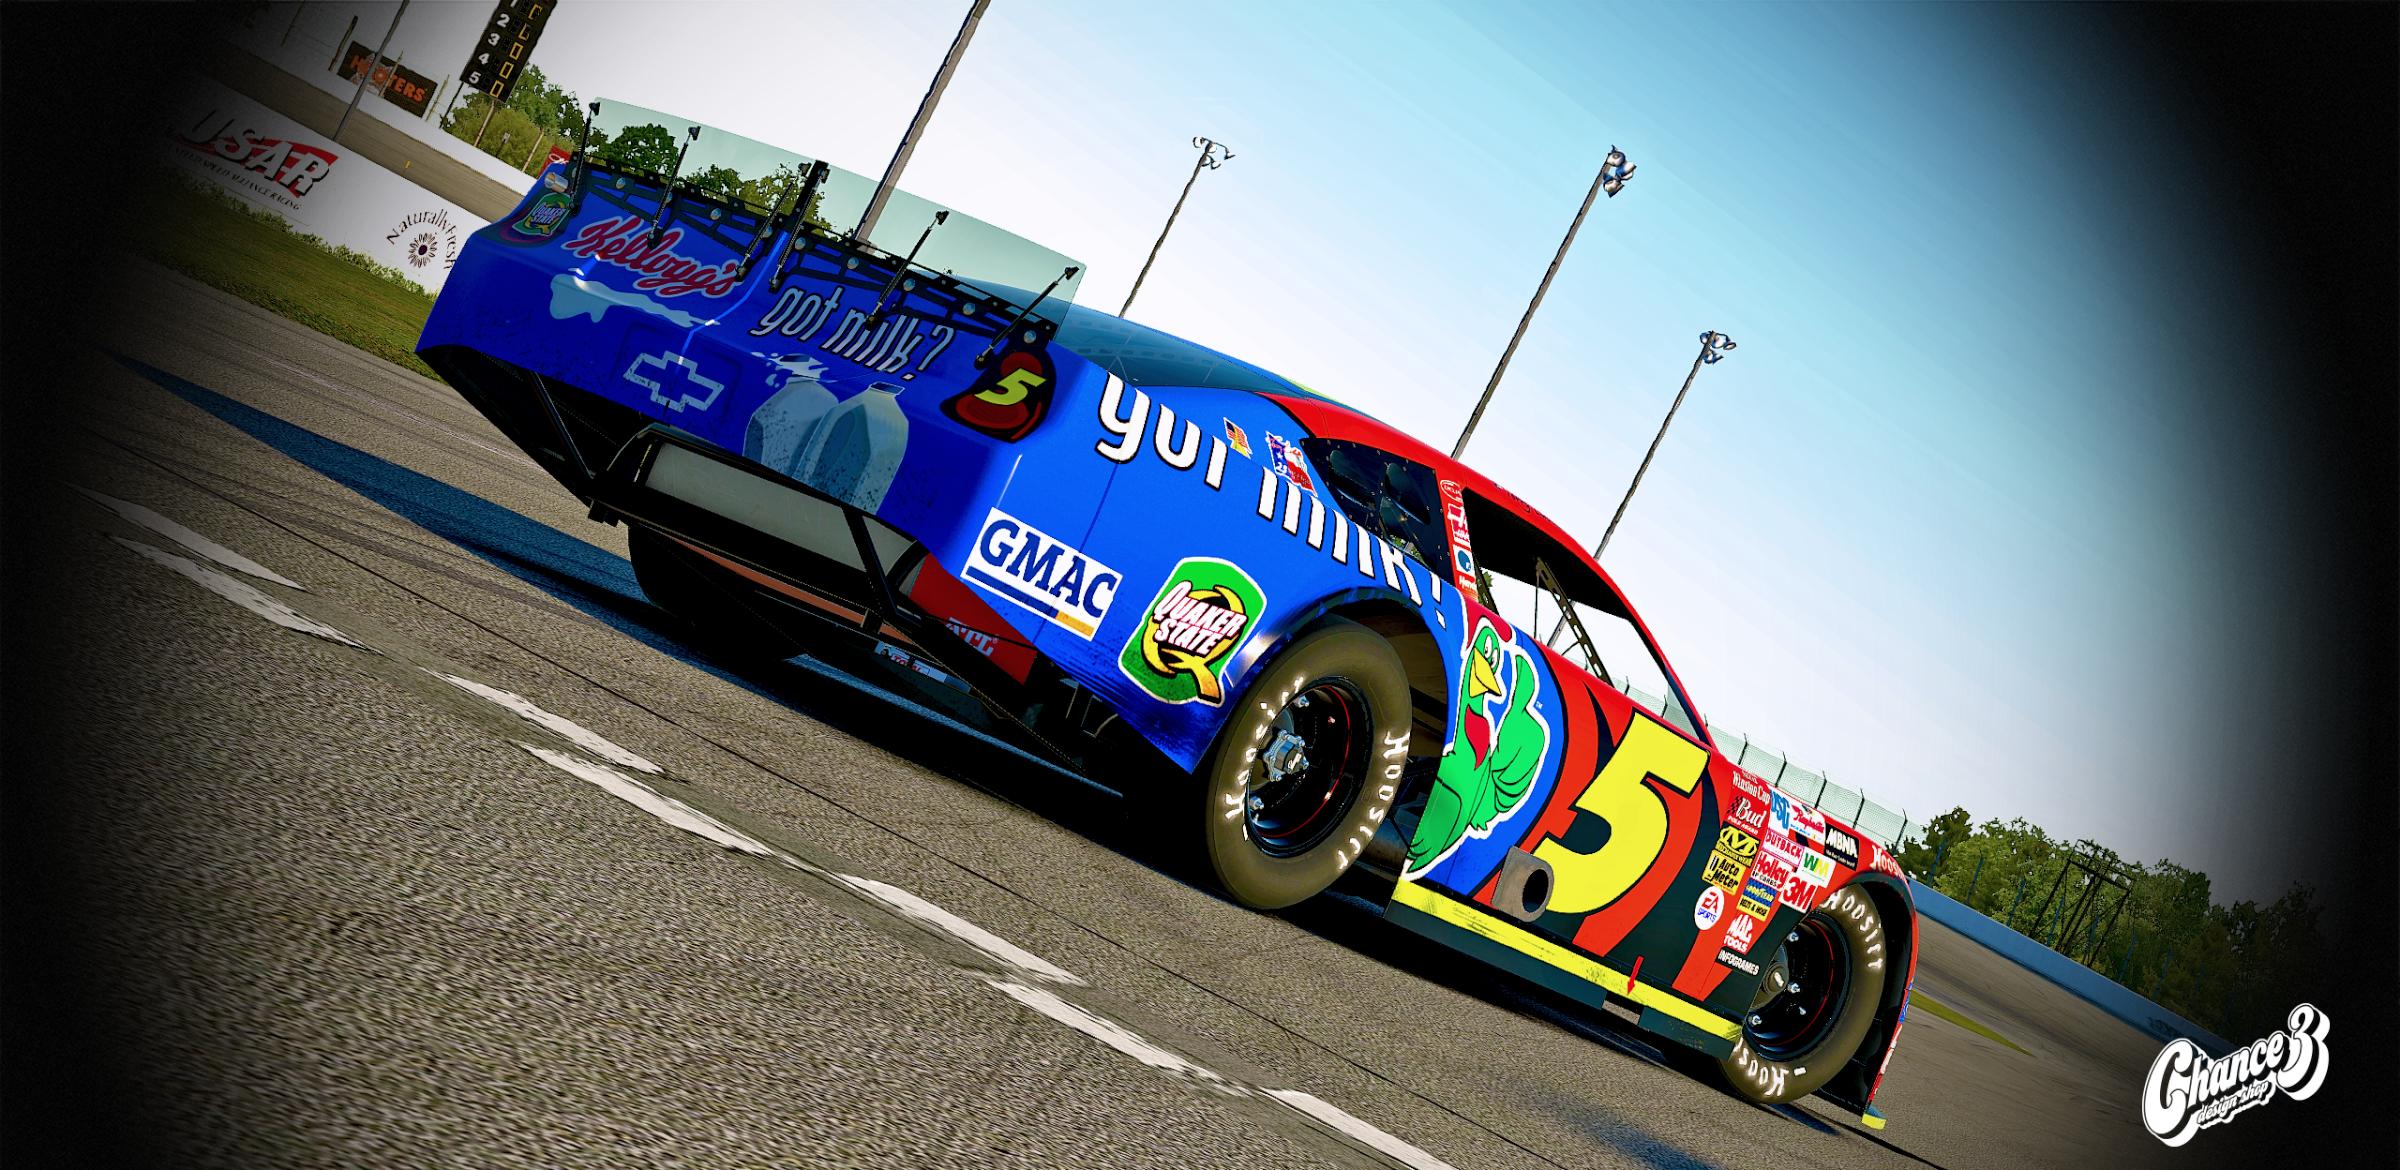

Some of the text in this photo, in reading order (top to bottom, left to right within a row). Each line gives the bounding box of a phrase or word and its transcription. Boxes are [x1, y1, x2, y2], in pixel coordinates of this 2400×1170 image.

[497, 13, 510, 28] 2
[487, 32, 500, 47] 3
[478, 52, 490, 66] 4
[469, 71, 481, 85] 5
[178, 108, 330, 197] USAR
[562, 214, 740, 298] Kellogg's
[750, 285, 956, 382] got milk?
[974, 368, 1048, 406] 5
[979, 518, 1117, 619] GMAC
[1153, 579, 1248, 637] QUAKER
[1155, 617, 1223, 657] STATE
[1531, 712, 1712, 915] 5
[1735, 797, 1768, 828] Bud
[1765, 830, 1802, 859] OUTBACK
[1825, 828, 1858, 859] MBNA
[1713, 869, 1739, 889] Meter
[1719, 858, 1740, 877] Auto
[1756, 851, 1789, 889] Holley
[1803, 852, 1831, 877] WM
[1701, 891, 1719, 914] EA
[1782, 876, 1818, 910] 3M
[1723, 934, 1748, 953] TOOLS
[1726, 914, 1754, 944] MAC
[1717, 950, 1760, 976] INFOGRAMES
